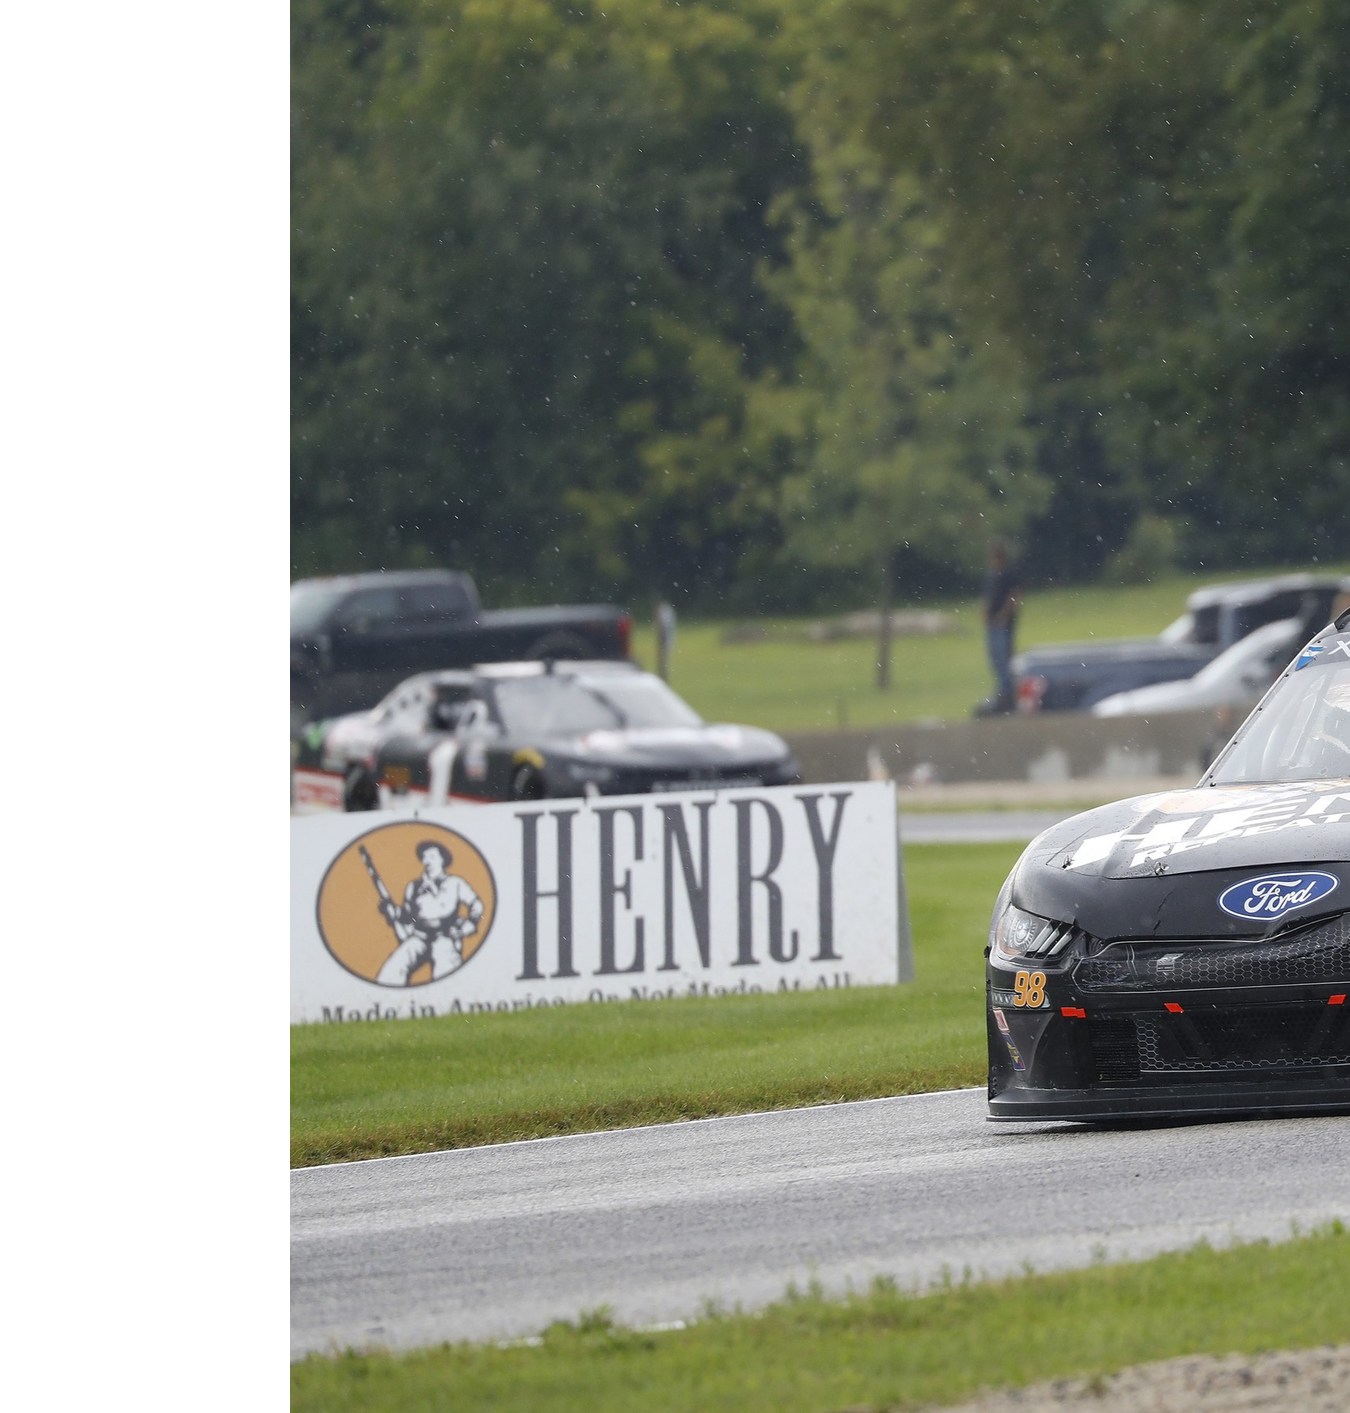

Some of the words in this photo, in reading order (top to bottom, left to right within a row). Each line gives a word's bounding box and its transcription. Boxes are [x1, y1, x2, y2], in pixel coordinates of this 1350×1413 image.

[514, 792, 854, 981] HENRY
[1244, 880, 1316, 913] Ford
[1013, 970, 1047, 1008] 98
